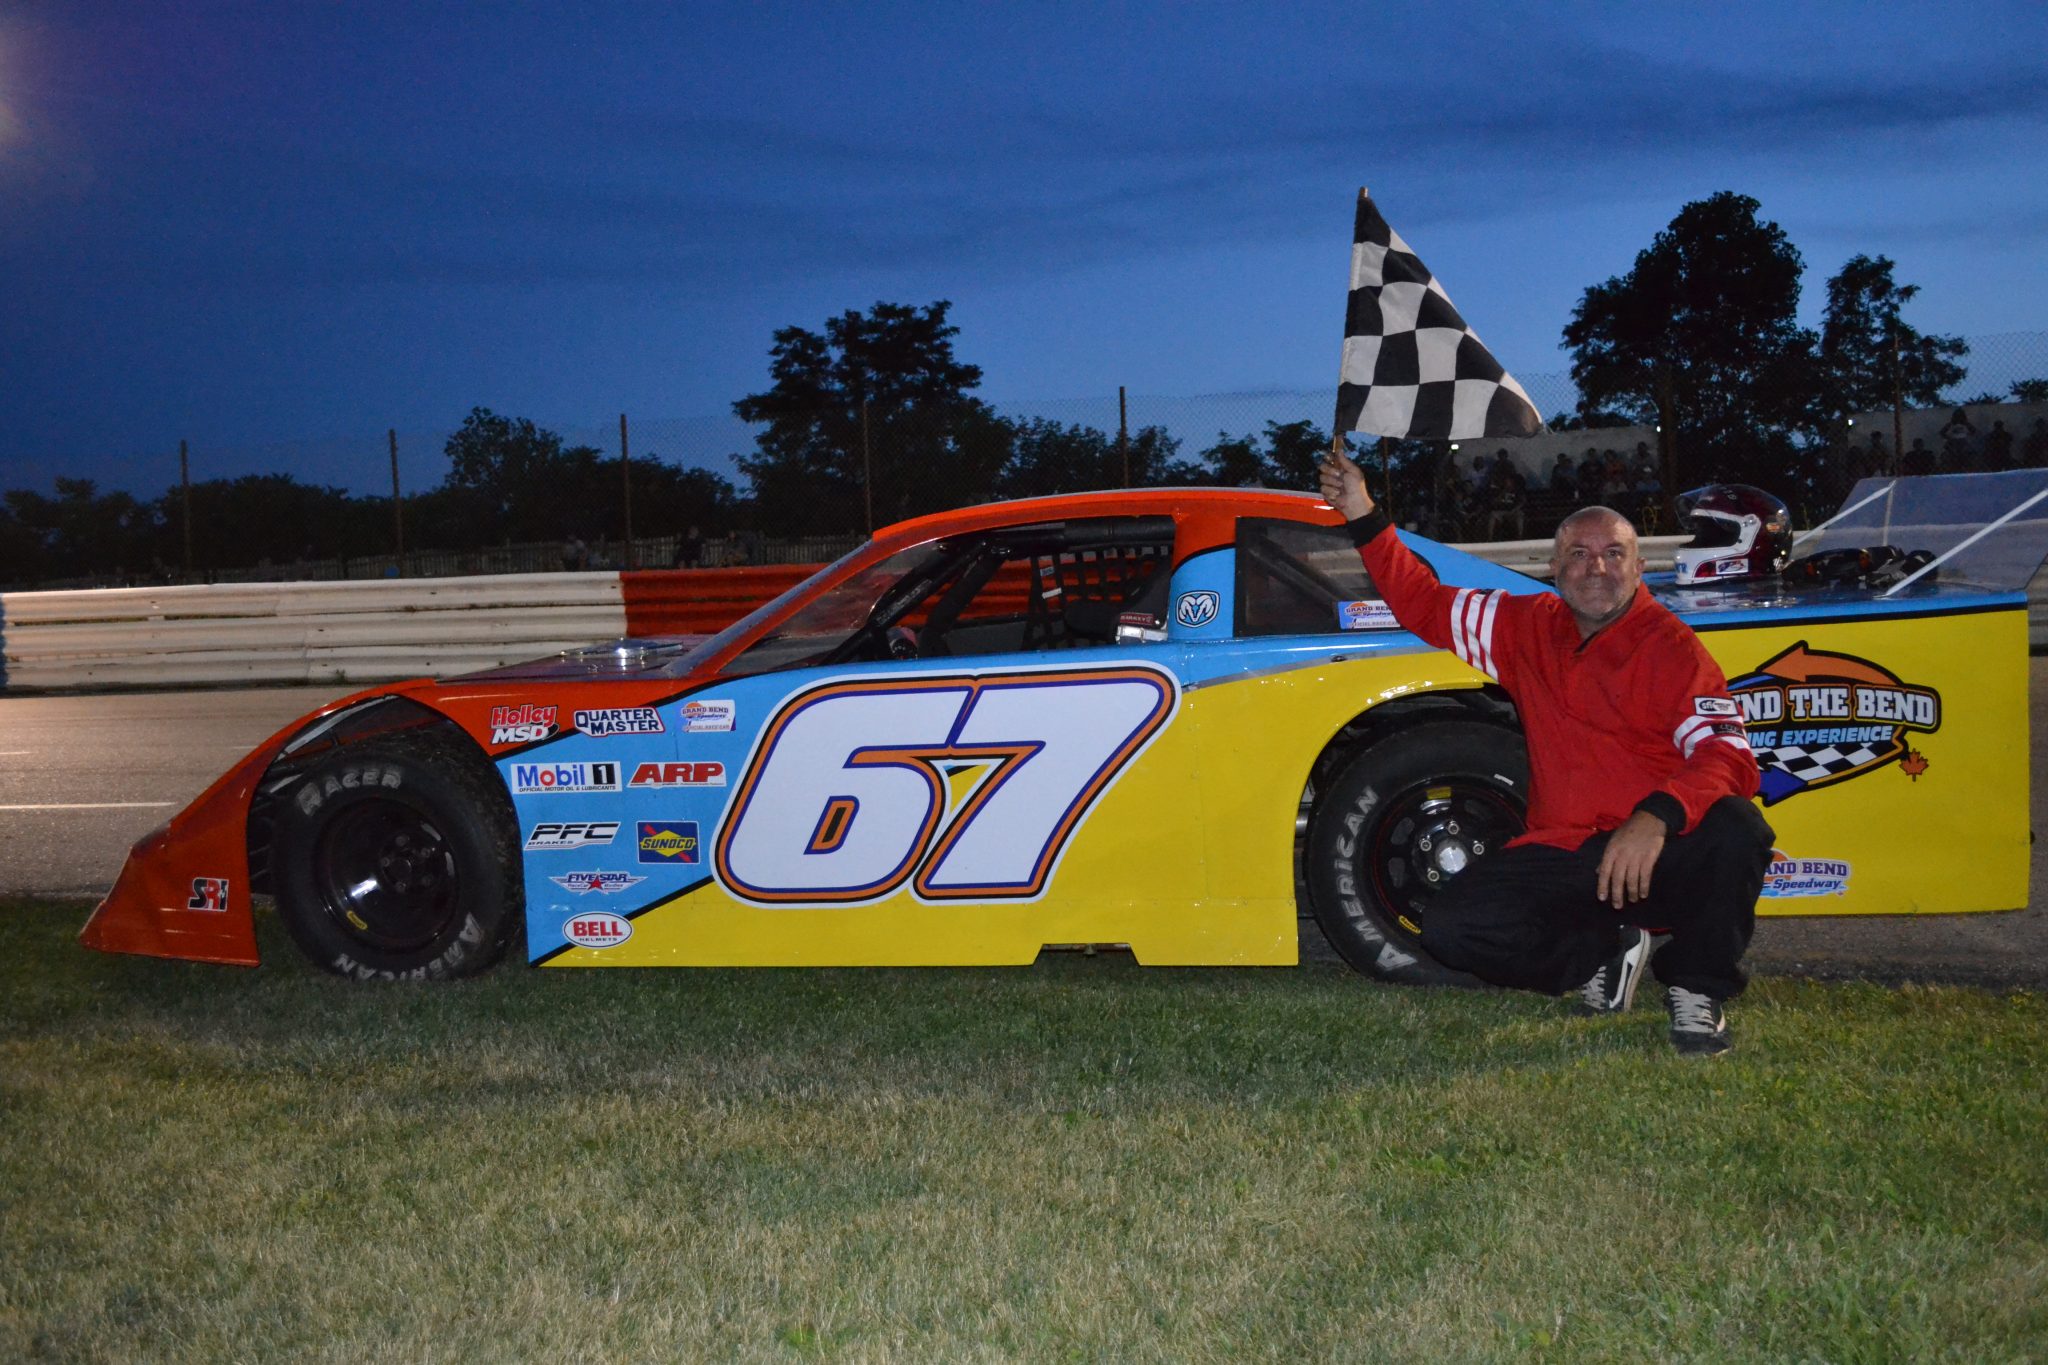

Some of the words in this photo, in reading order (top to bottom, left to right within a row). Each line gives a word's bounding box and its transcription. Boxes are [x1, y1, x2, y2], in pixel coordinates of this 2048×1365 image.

[1346, 605, 1373, 613] GRAND
[682, 706, 706, 714] GRAND
[1790, 687, 1849, 718] THE
[1855, 688, 1934, 725] BEND
[488, 704, 557, 729] Holley
[575, 708, 654, 728] QUARTER
[491, 725, 549, 744] MSD
[590, 720, 659, 735] MASTER
[1781, 726, 1893, 746] EXPERIENCE
[517, 764, 585, 787] Mobil
[630, 763, 724, 783] ARP
[296, 769, 402, 816] RACER
[714, 666, 1175, 903] 67
[530, 823, 619, 841] PFC
[642, 837, 694, 850] SUNOCO
[567, 873, 598, 883] FIVE
[600, 873, 628, 883] STAR
[1334, 786, 1418, 971] AMERICAN
[1802, 862, 1847, 876] BEND
[1773, 878, 1842, 890] Speedway
[572, 921, 624, 937] BELL
